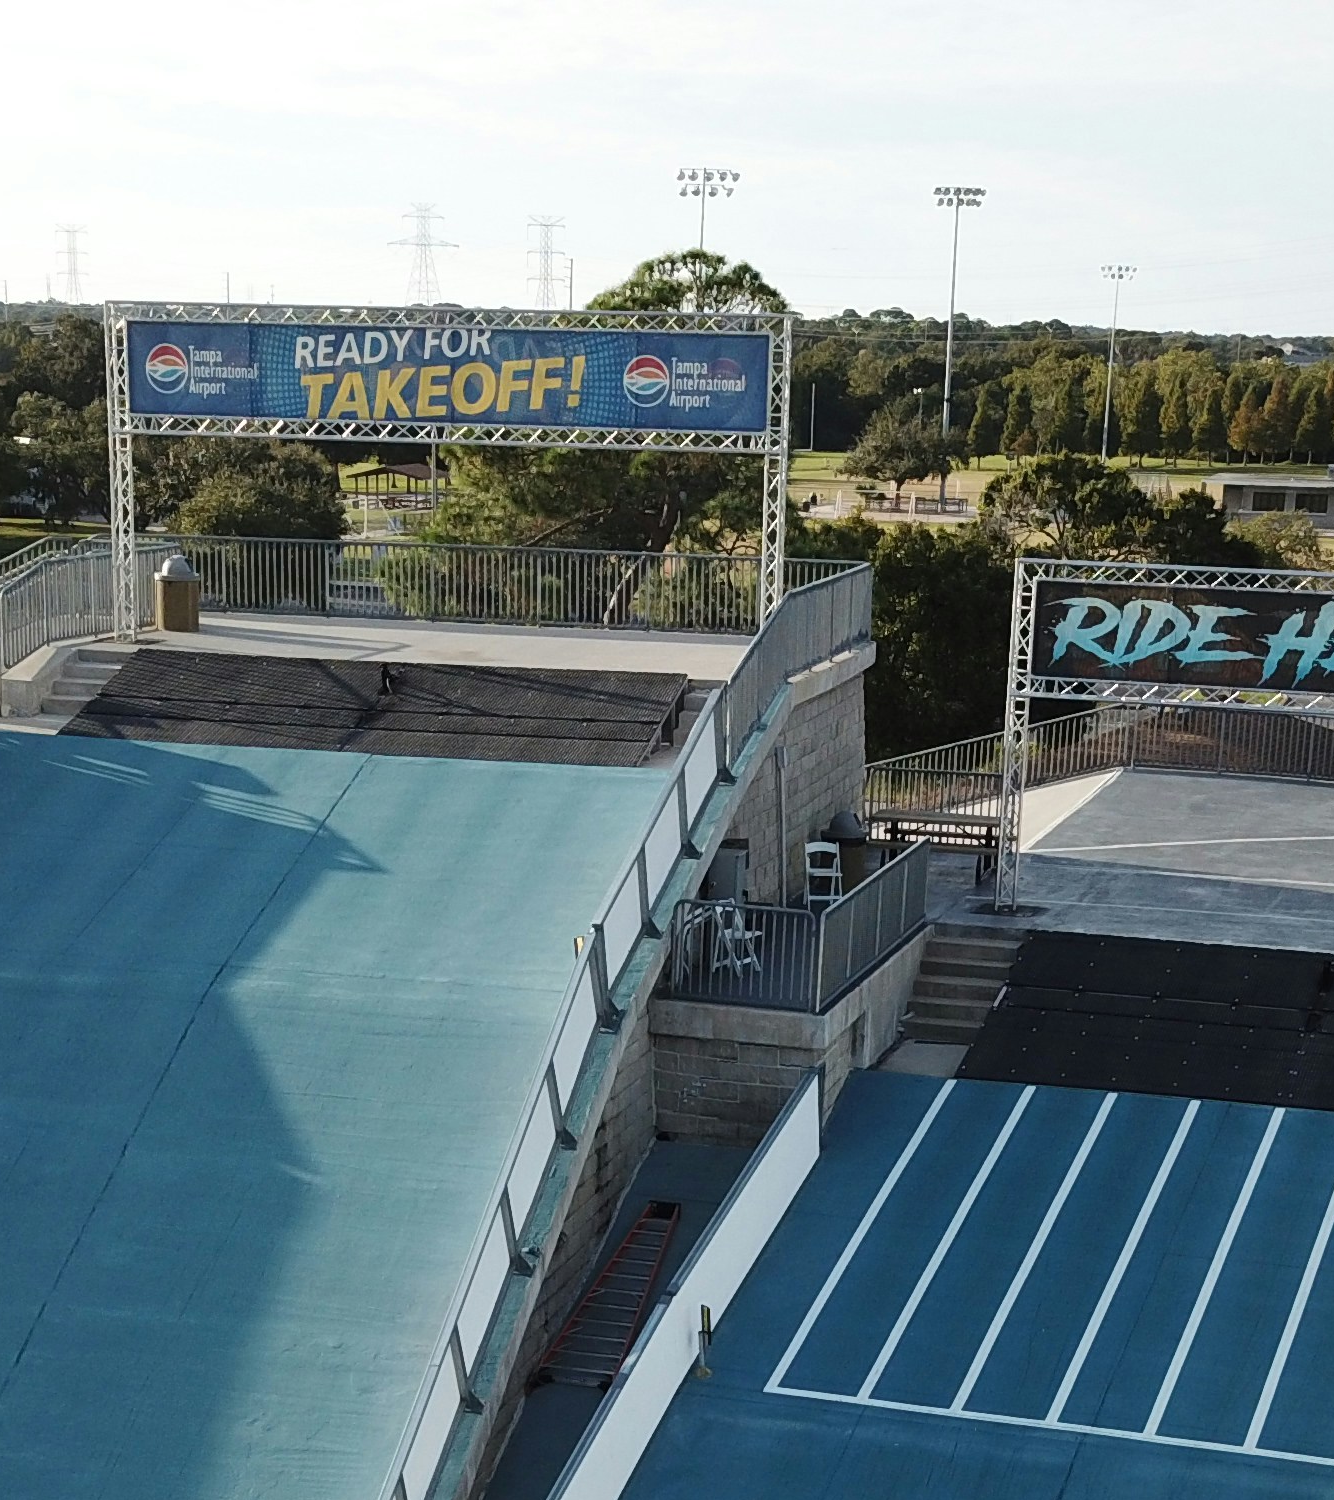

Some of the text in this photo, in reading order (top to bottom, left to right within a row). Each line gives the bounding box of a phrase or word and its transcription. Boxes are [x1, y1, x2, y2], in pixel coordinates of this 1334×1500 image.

[188, 345, 223, 366] Tampa
[294, 328, 492, 369] READY FOR
[189, 361, 260, 380] International
[671, 357, 708, 380] Tampa
[188, 377, 226, 400] Airport
[300, 355, 586, 420] TAKEOFF!
[671, 374, 747, 392] International
[669, 390, 711, 412] Airport
[1043, 595, 1267, 670] RIDE
